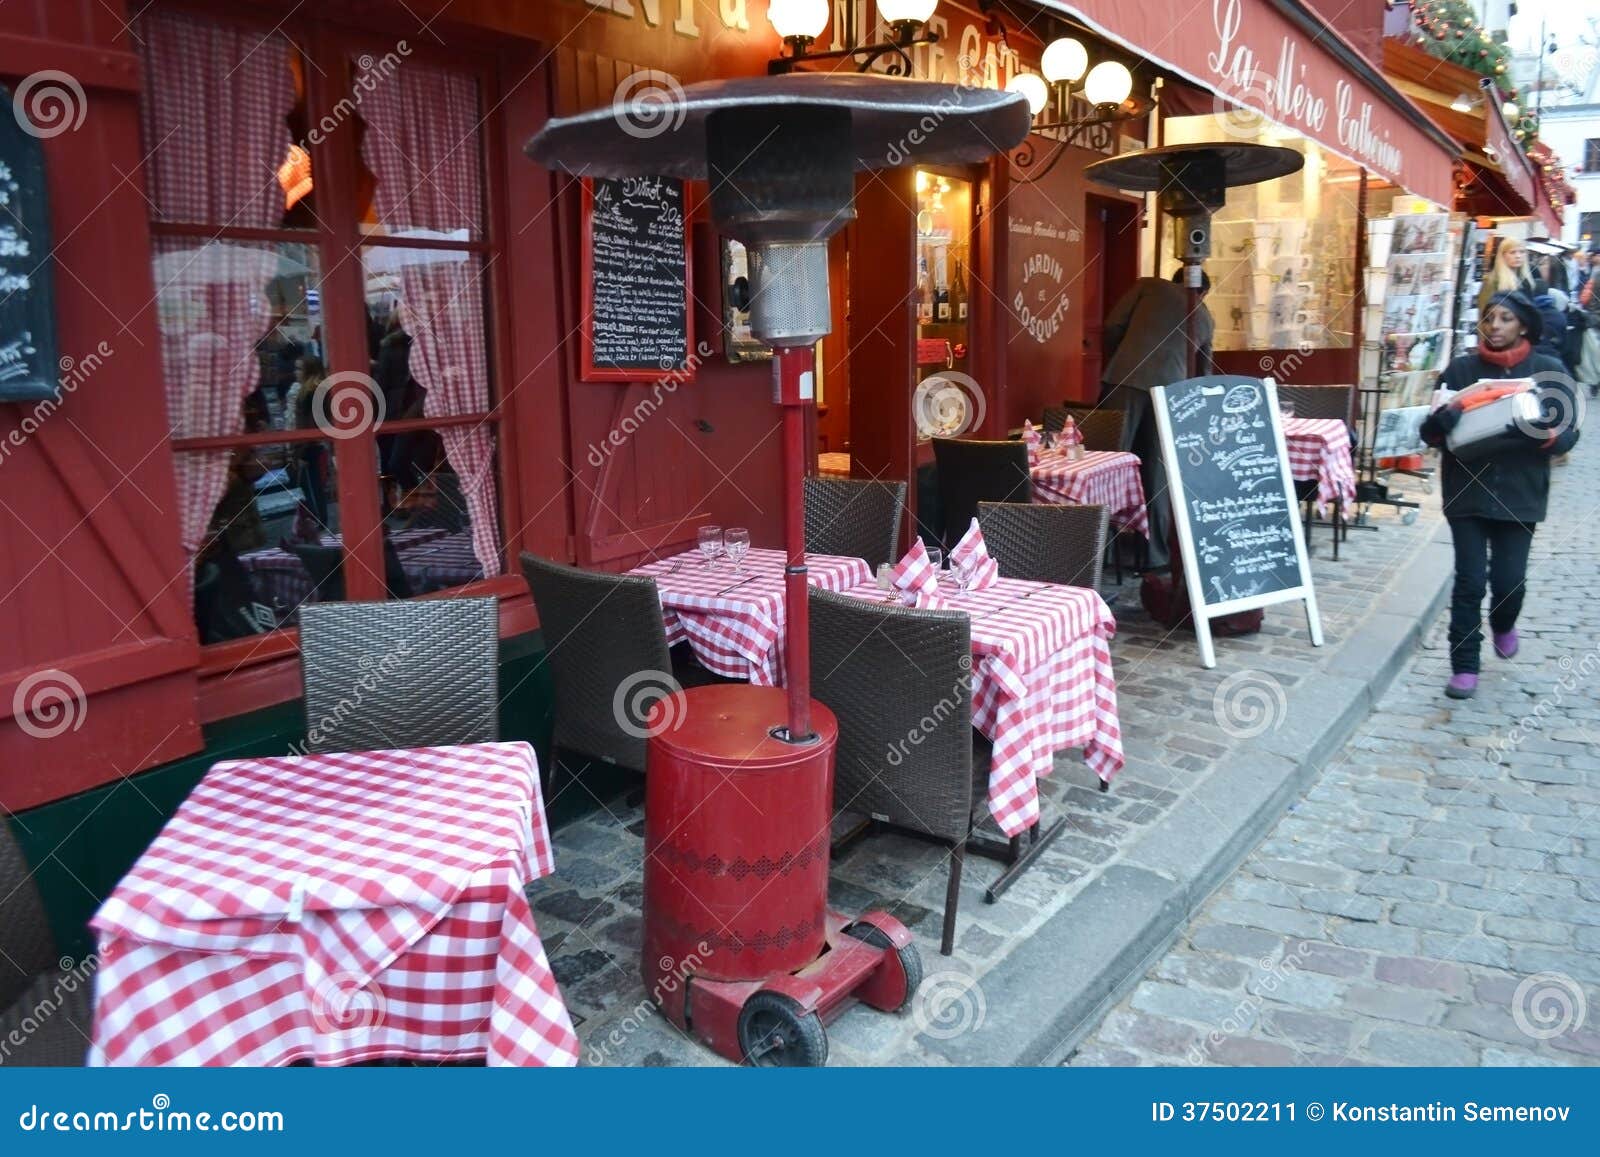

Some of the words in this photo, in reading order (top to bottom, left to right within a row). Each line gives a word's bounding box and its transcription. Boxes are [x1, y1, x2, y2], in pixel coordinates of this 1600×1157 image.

[1208, 0, 1260, 92] La
[1024, 254, 1063, 284] JARDIN
[1014, 290, 1069, 343] BOSQUETS
